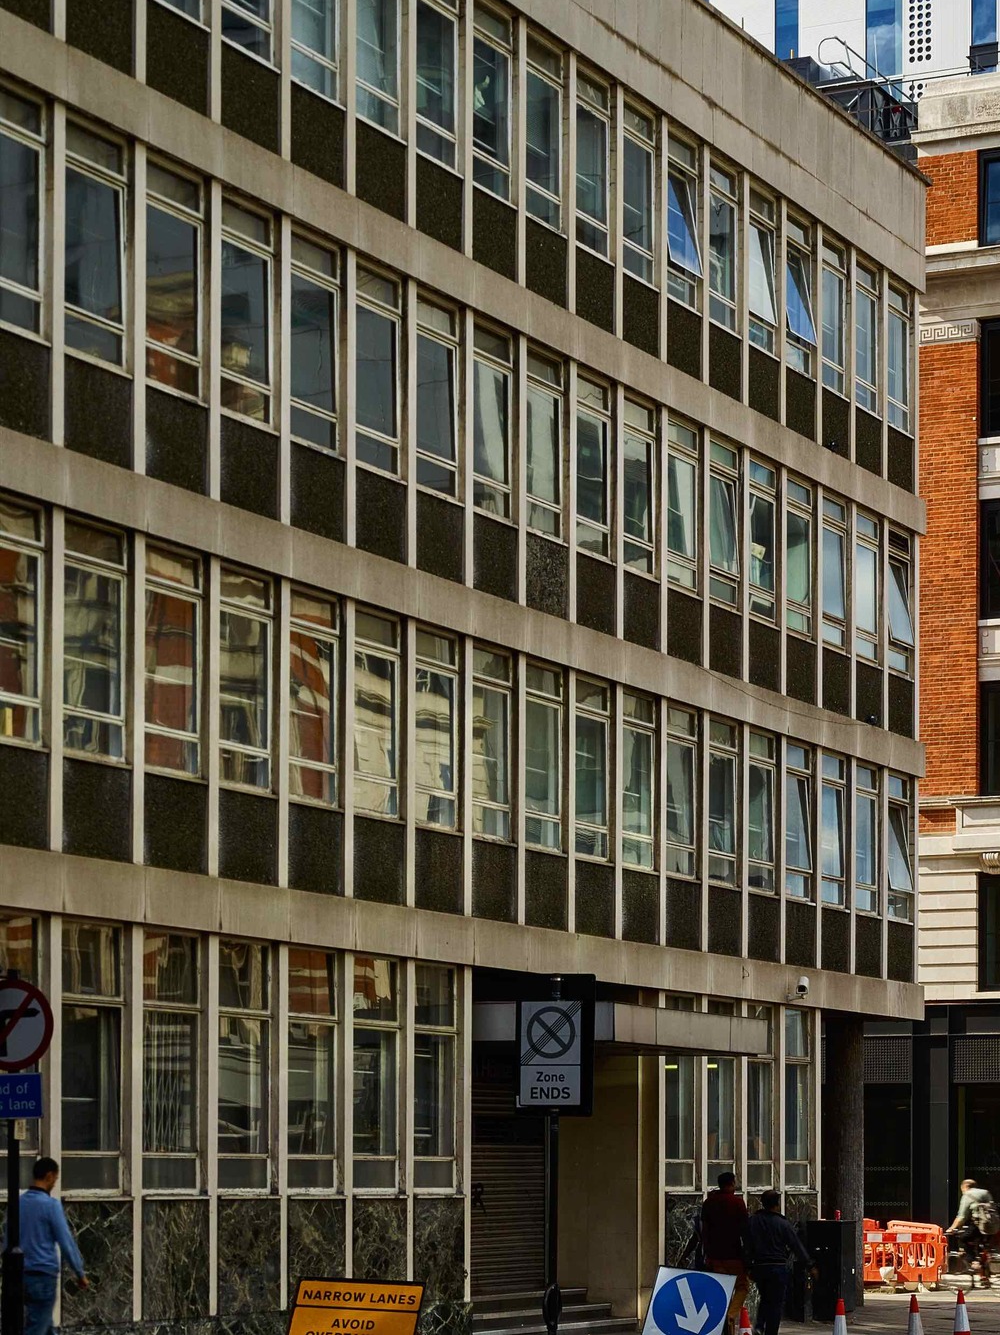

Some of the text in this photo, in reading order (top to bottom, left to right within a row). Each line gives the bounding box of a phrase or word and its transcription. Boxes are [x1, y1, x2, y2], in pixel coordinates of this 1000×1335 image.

[536, 1071, 565, 1082] Zone
[16, 1082, 28, 1094] of
[530, 1086, 570, 1100] ENDS
[9, 1098, 36, 1110] lane
[302, 1290, 416, 1305] NARROW LANES
[331, 1318, 376, 1330] AVOID
